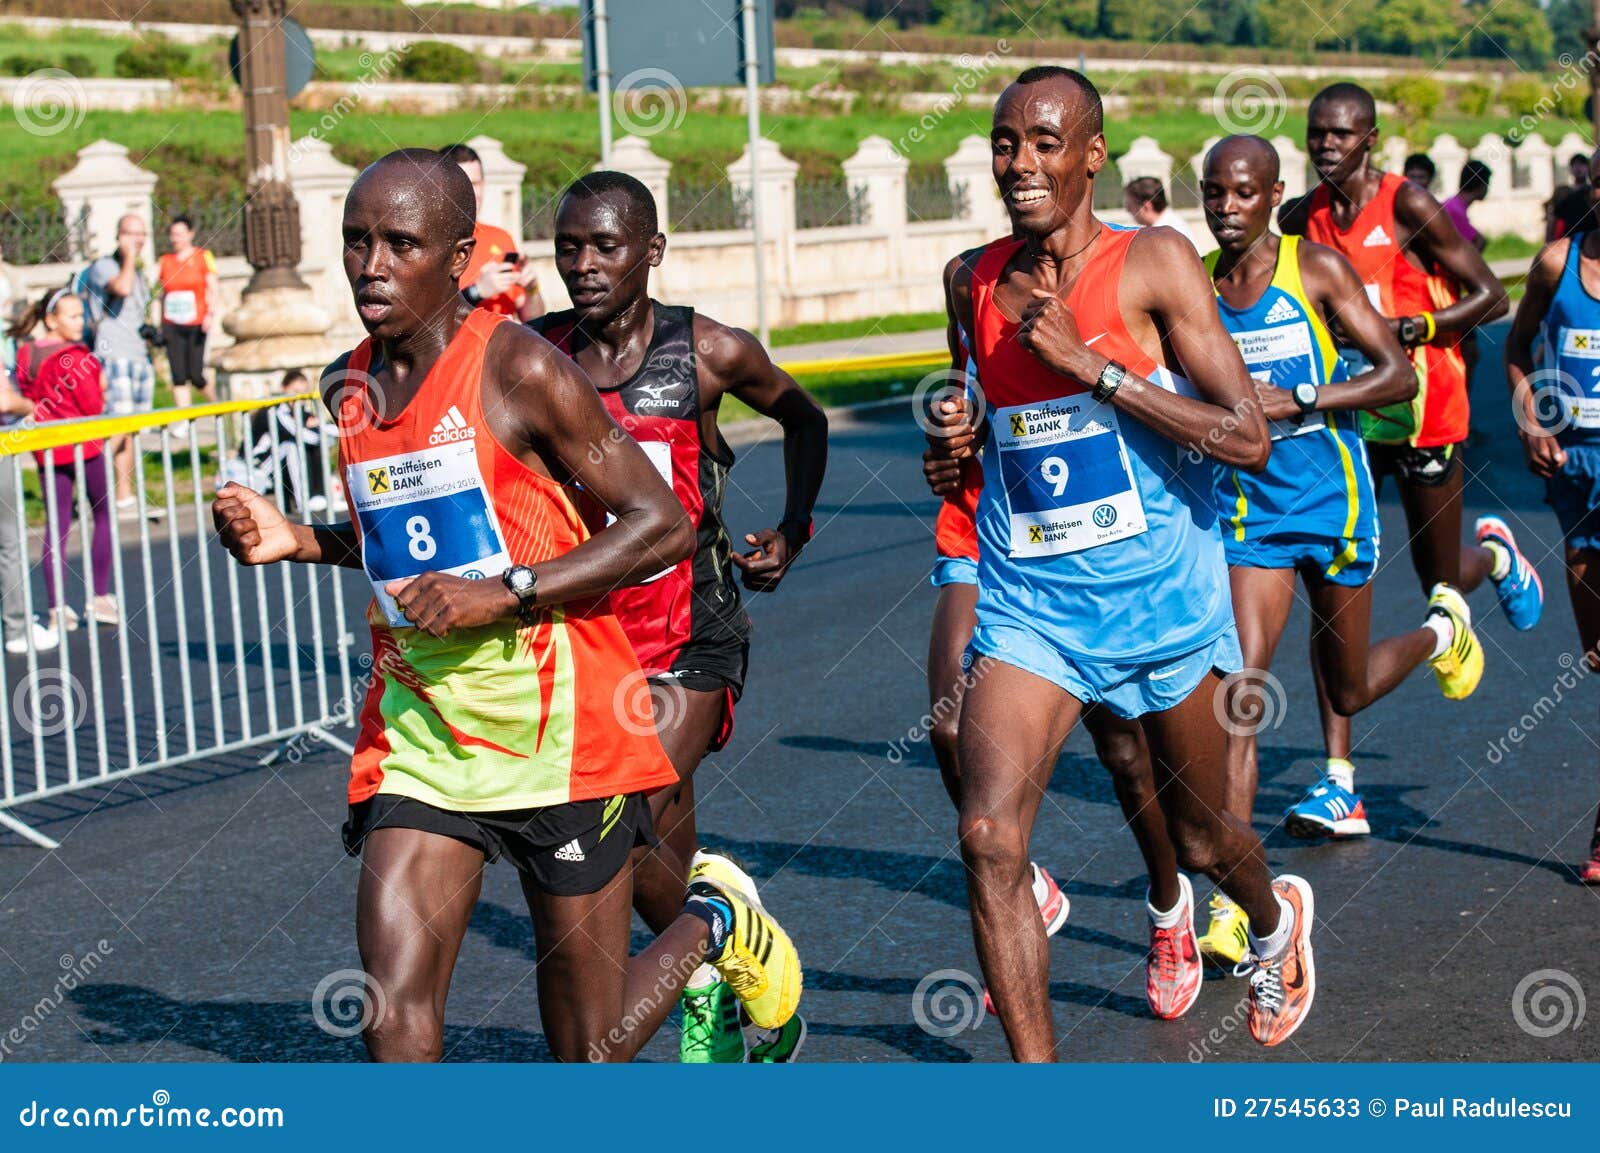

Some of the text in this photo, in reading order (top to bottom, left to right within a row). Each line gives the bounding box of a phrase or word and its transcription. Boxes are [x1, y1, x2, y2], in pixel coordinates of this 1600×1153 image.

[1264, 309, 1300, 324] adidas
[1242, 334, 1285, 345] Raiffeisen
[1243, 345, 1269, 354] BANK
[1025, 403, 1081, 422] Raiffeisen
[428, 426, 476, 445] adidas
[1029, 420, 1061, 435] BANK
[1054, 427, 1094, 440] MARATHON
[1096, 421, 1113, 431] 2012
[389, 458, 442, 476] Raiffeisen
[393, 474, 424, 491] BANK
[1040, 456, 1069, 497] 9
[417, 482, 456, 497] MARATHON
[456, 477, 478, 489] 2012
[1041, 519, 1083, 533] Raiffeisen
[405, 515, 437, 561] 8
[1044, 531, 1068, 543] BANK
[554, 851, 585, 862] adidas
